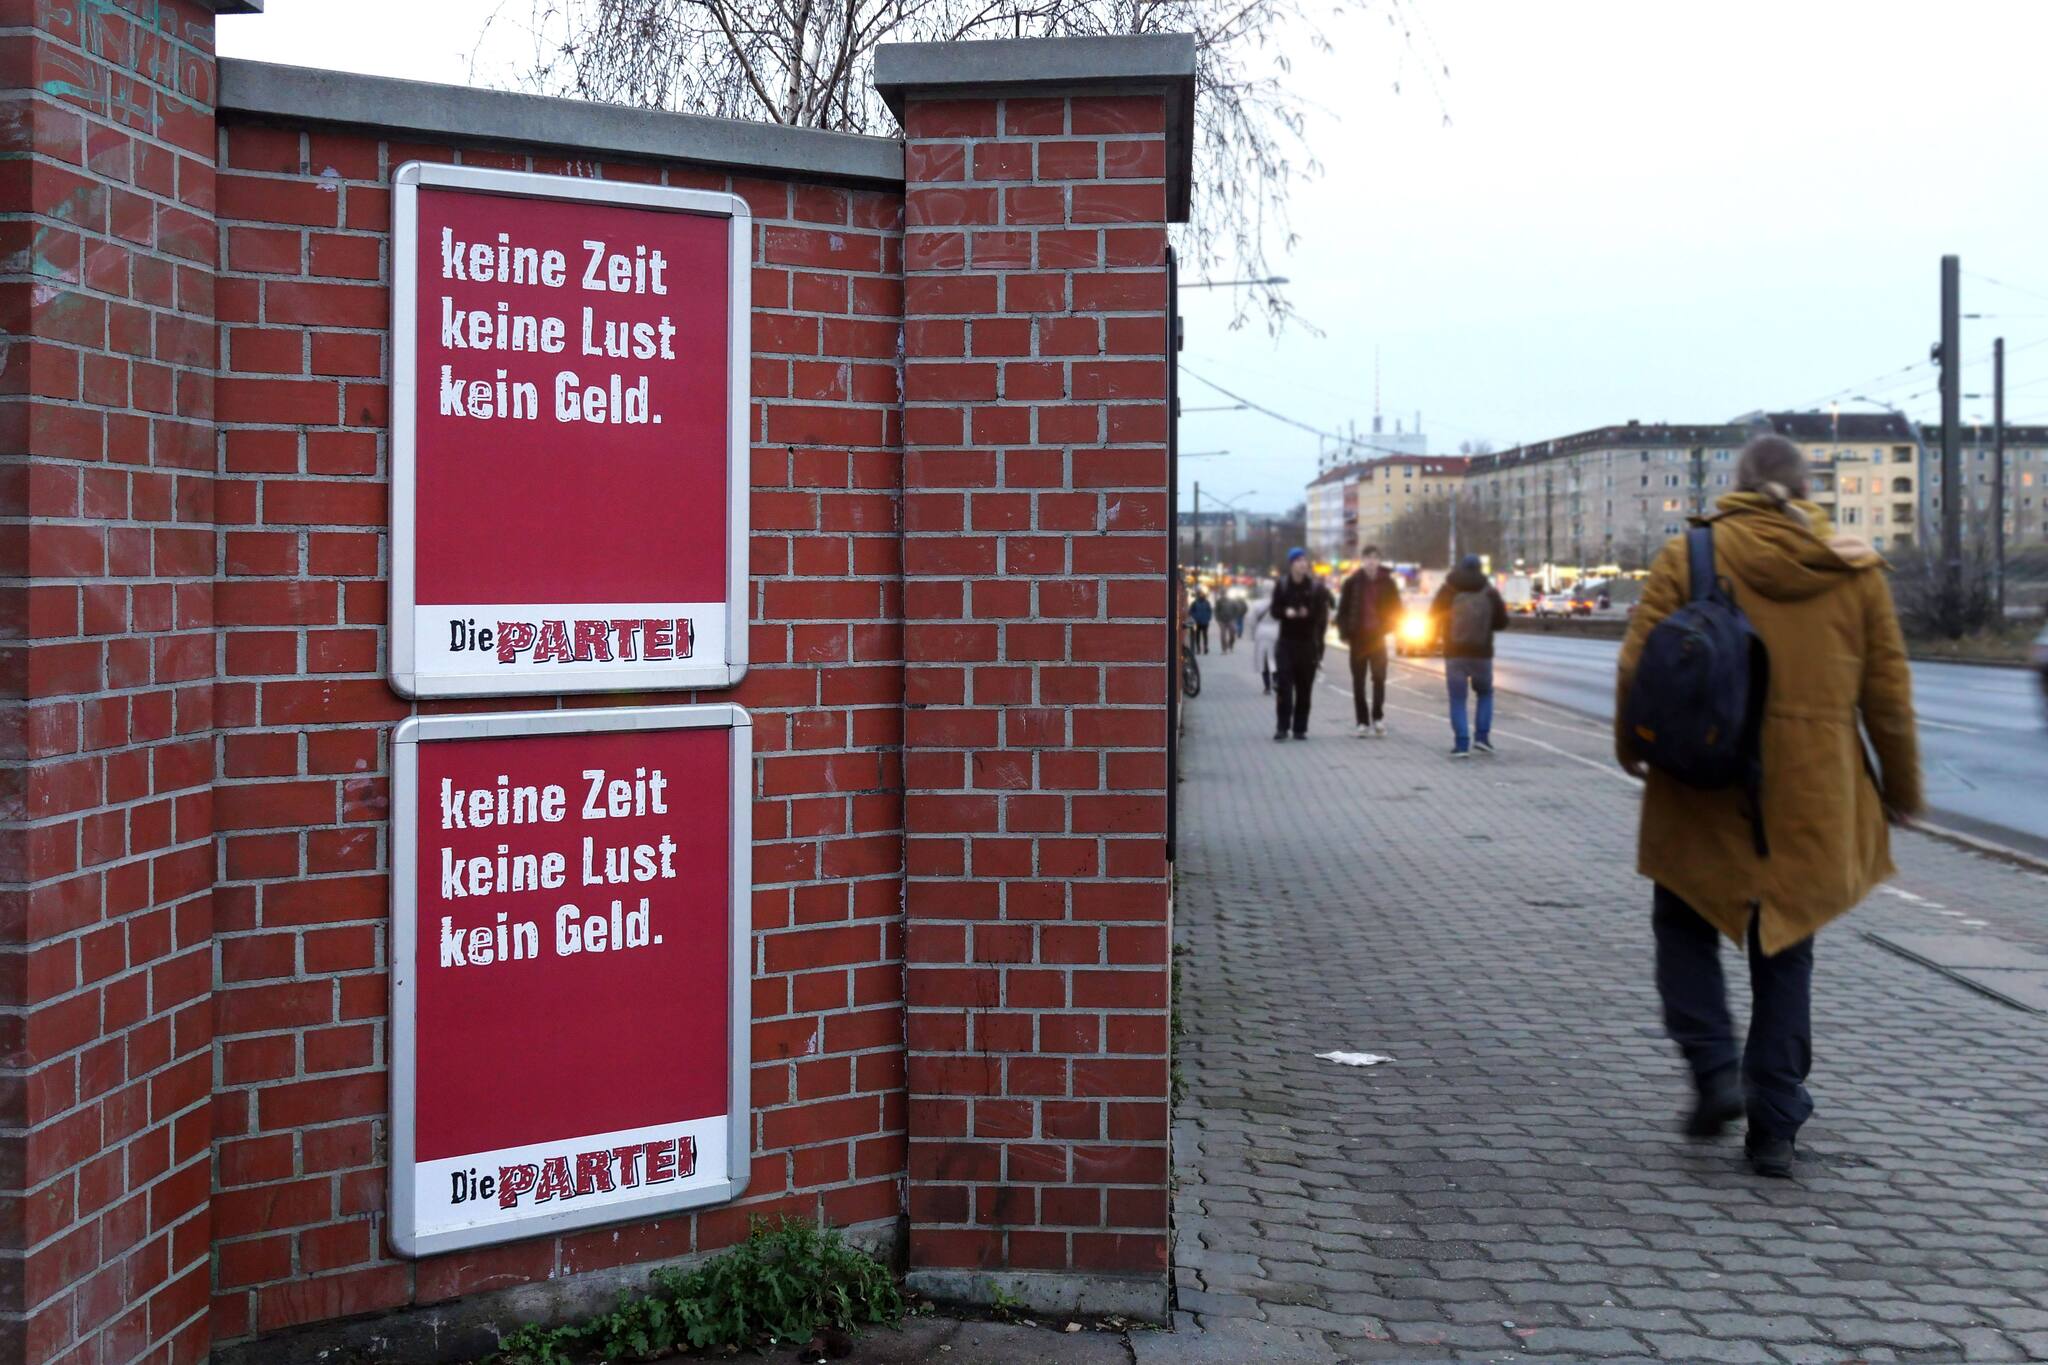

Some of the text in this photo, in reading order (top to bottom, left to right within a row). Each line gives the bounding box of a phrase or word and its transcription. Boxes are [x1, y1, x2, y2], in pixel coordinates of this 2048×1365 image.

[441, 227, 667, 295] keine Zeit
[442, 297, 676, 360] keine Lust
[440, 365, 661, 424] kein Geld.
[441, 767, 667, 829] keine Zeit
[441, 835, 676, 900] keine Lust
[440, 898, 662, 967] kein Geld.
